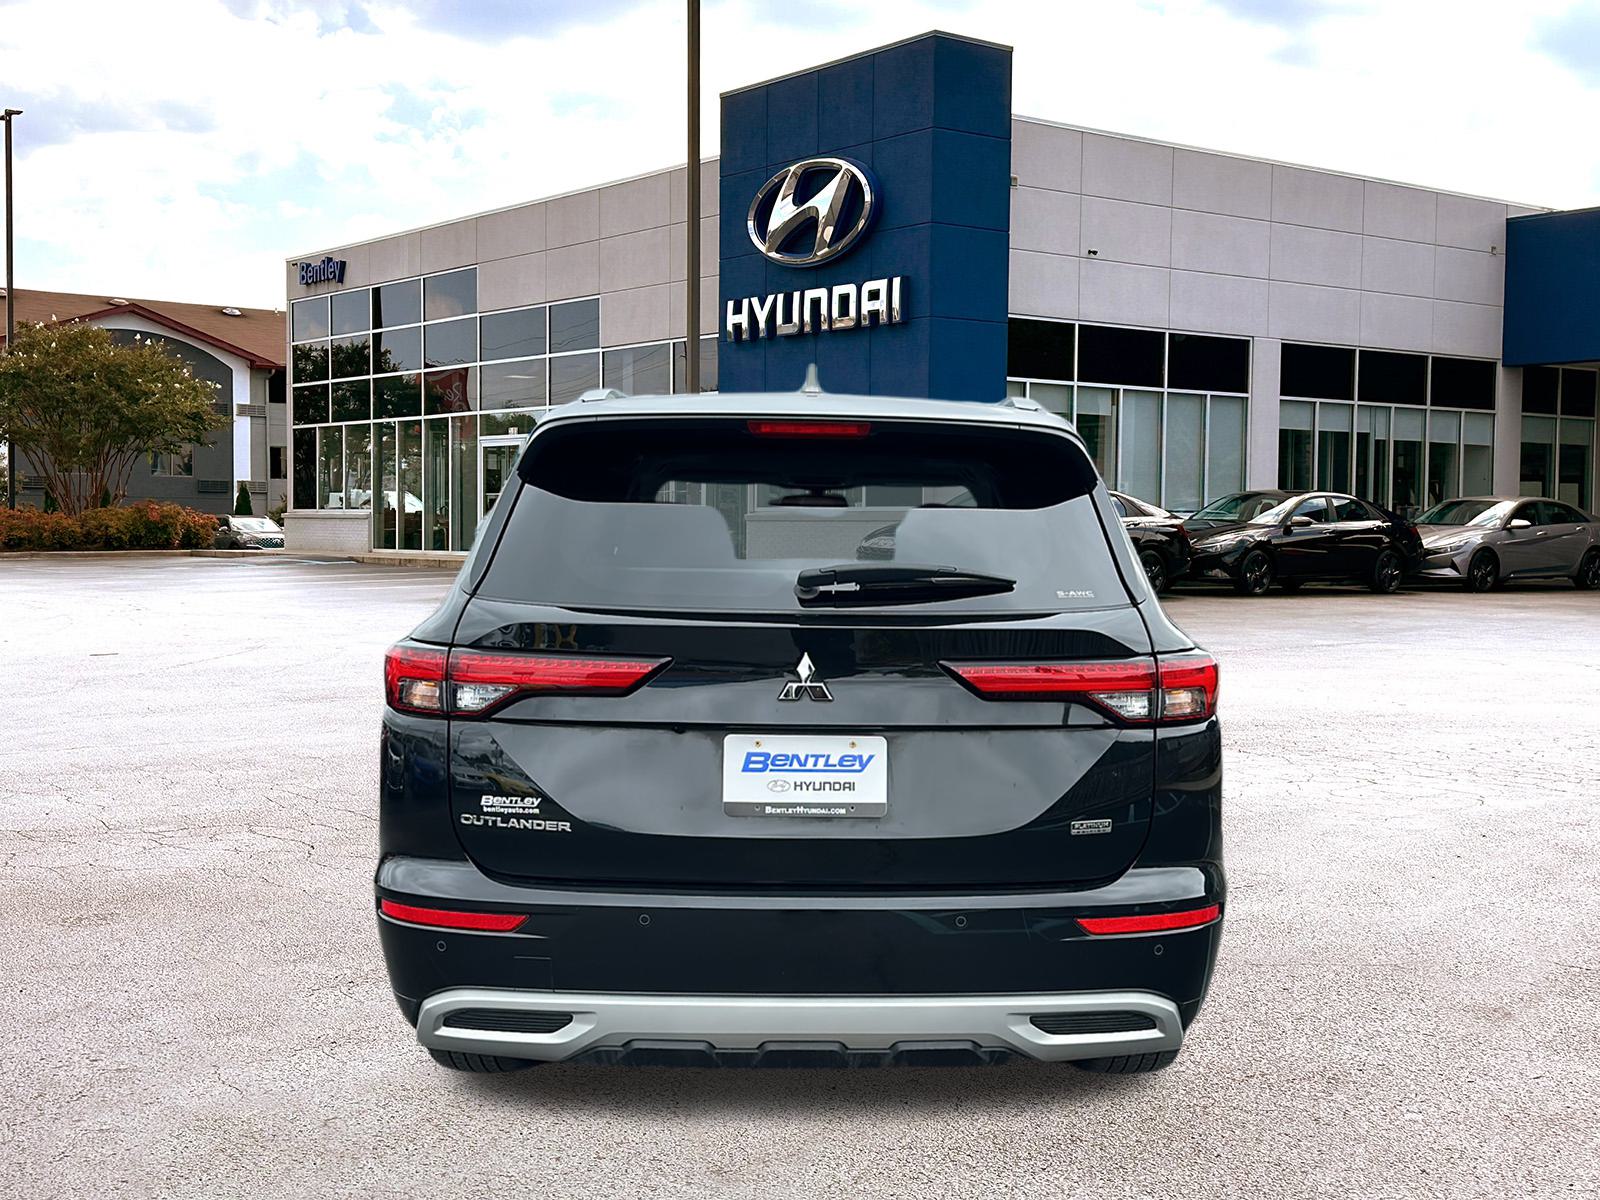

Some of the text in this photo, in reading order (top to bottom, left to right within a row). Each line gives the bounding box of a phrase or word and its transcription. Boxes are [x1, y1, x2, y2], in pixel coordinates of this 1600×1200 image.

[299, 257, 346, 285] Bentley
[726, 276, 907, 342] HYUNDAI
[793, 781, 856, 792] HYUNDAI
[483, 806, 540, 815] bentleyauto.com
[460, 814, 572, 832] OUTLANDER
